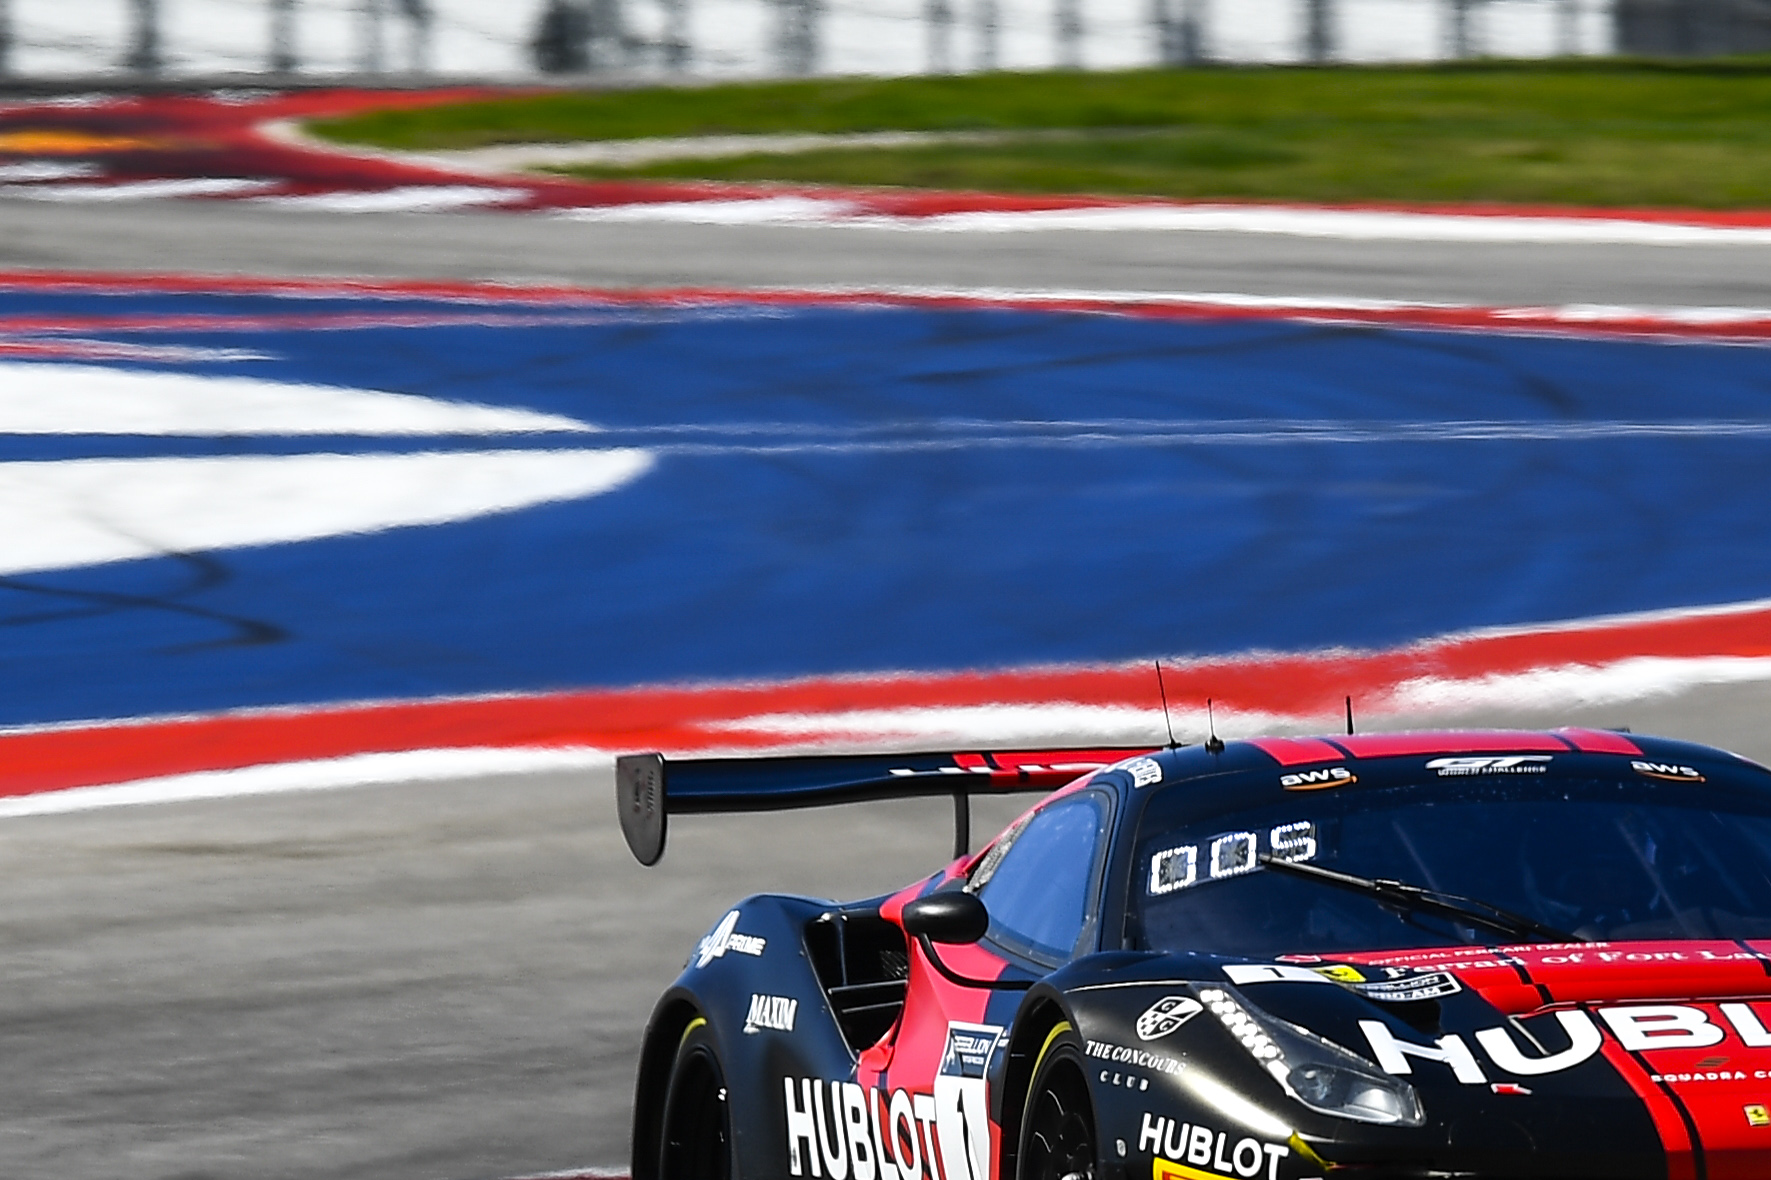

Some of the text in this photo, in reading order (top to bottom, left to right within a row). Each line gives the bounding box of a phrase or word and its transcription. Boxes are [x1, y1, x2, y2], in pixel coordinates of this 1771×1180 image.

[1425, 755, 1553, 769] GT
[1631, 760, 1699, 776] aws
[1280, 767, 1351, 786] aws
[1454, 945, 1532, 956] FERRARI
[1535, 941, 1611, 951] DEALER
[1380, 956, 1529, 979] Ferrari
[1541, 952, 1585, 964] of
[1597, 951, 1689, 963] Fort
[745, 994, 798, 1031] MAXIM
[1085, 1040, 1187, 1076] THE CONCOURS
[1099, 1070, 1149, 1091] CLUB
[1650, 1071, 1748, 1083] SQUADRA
